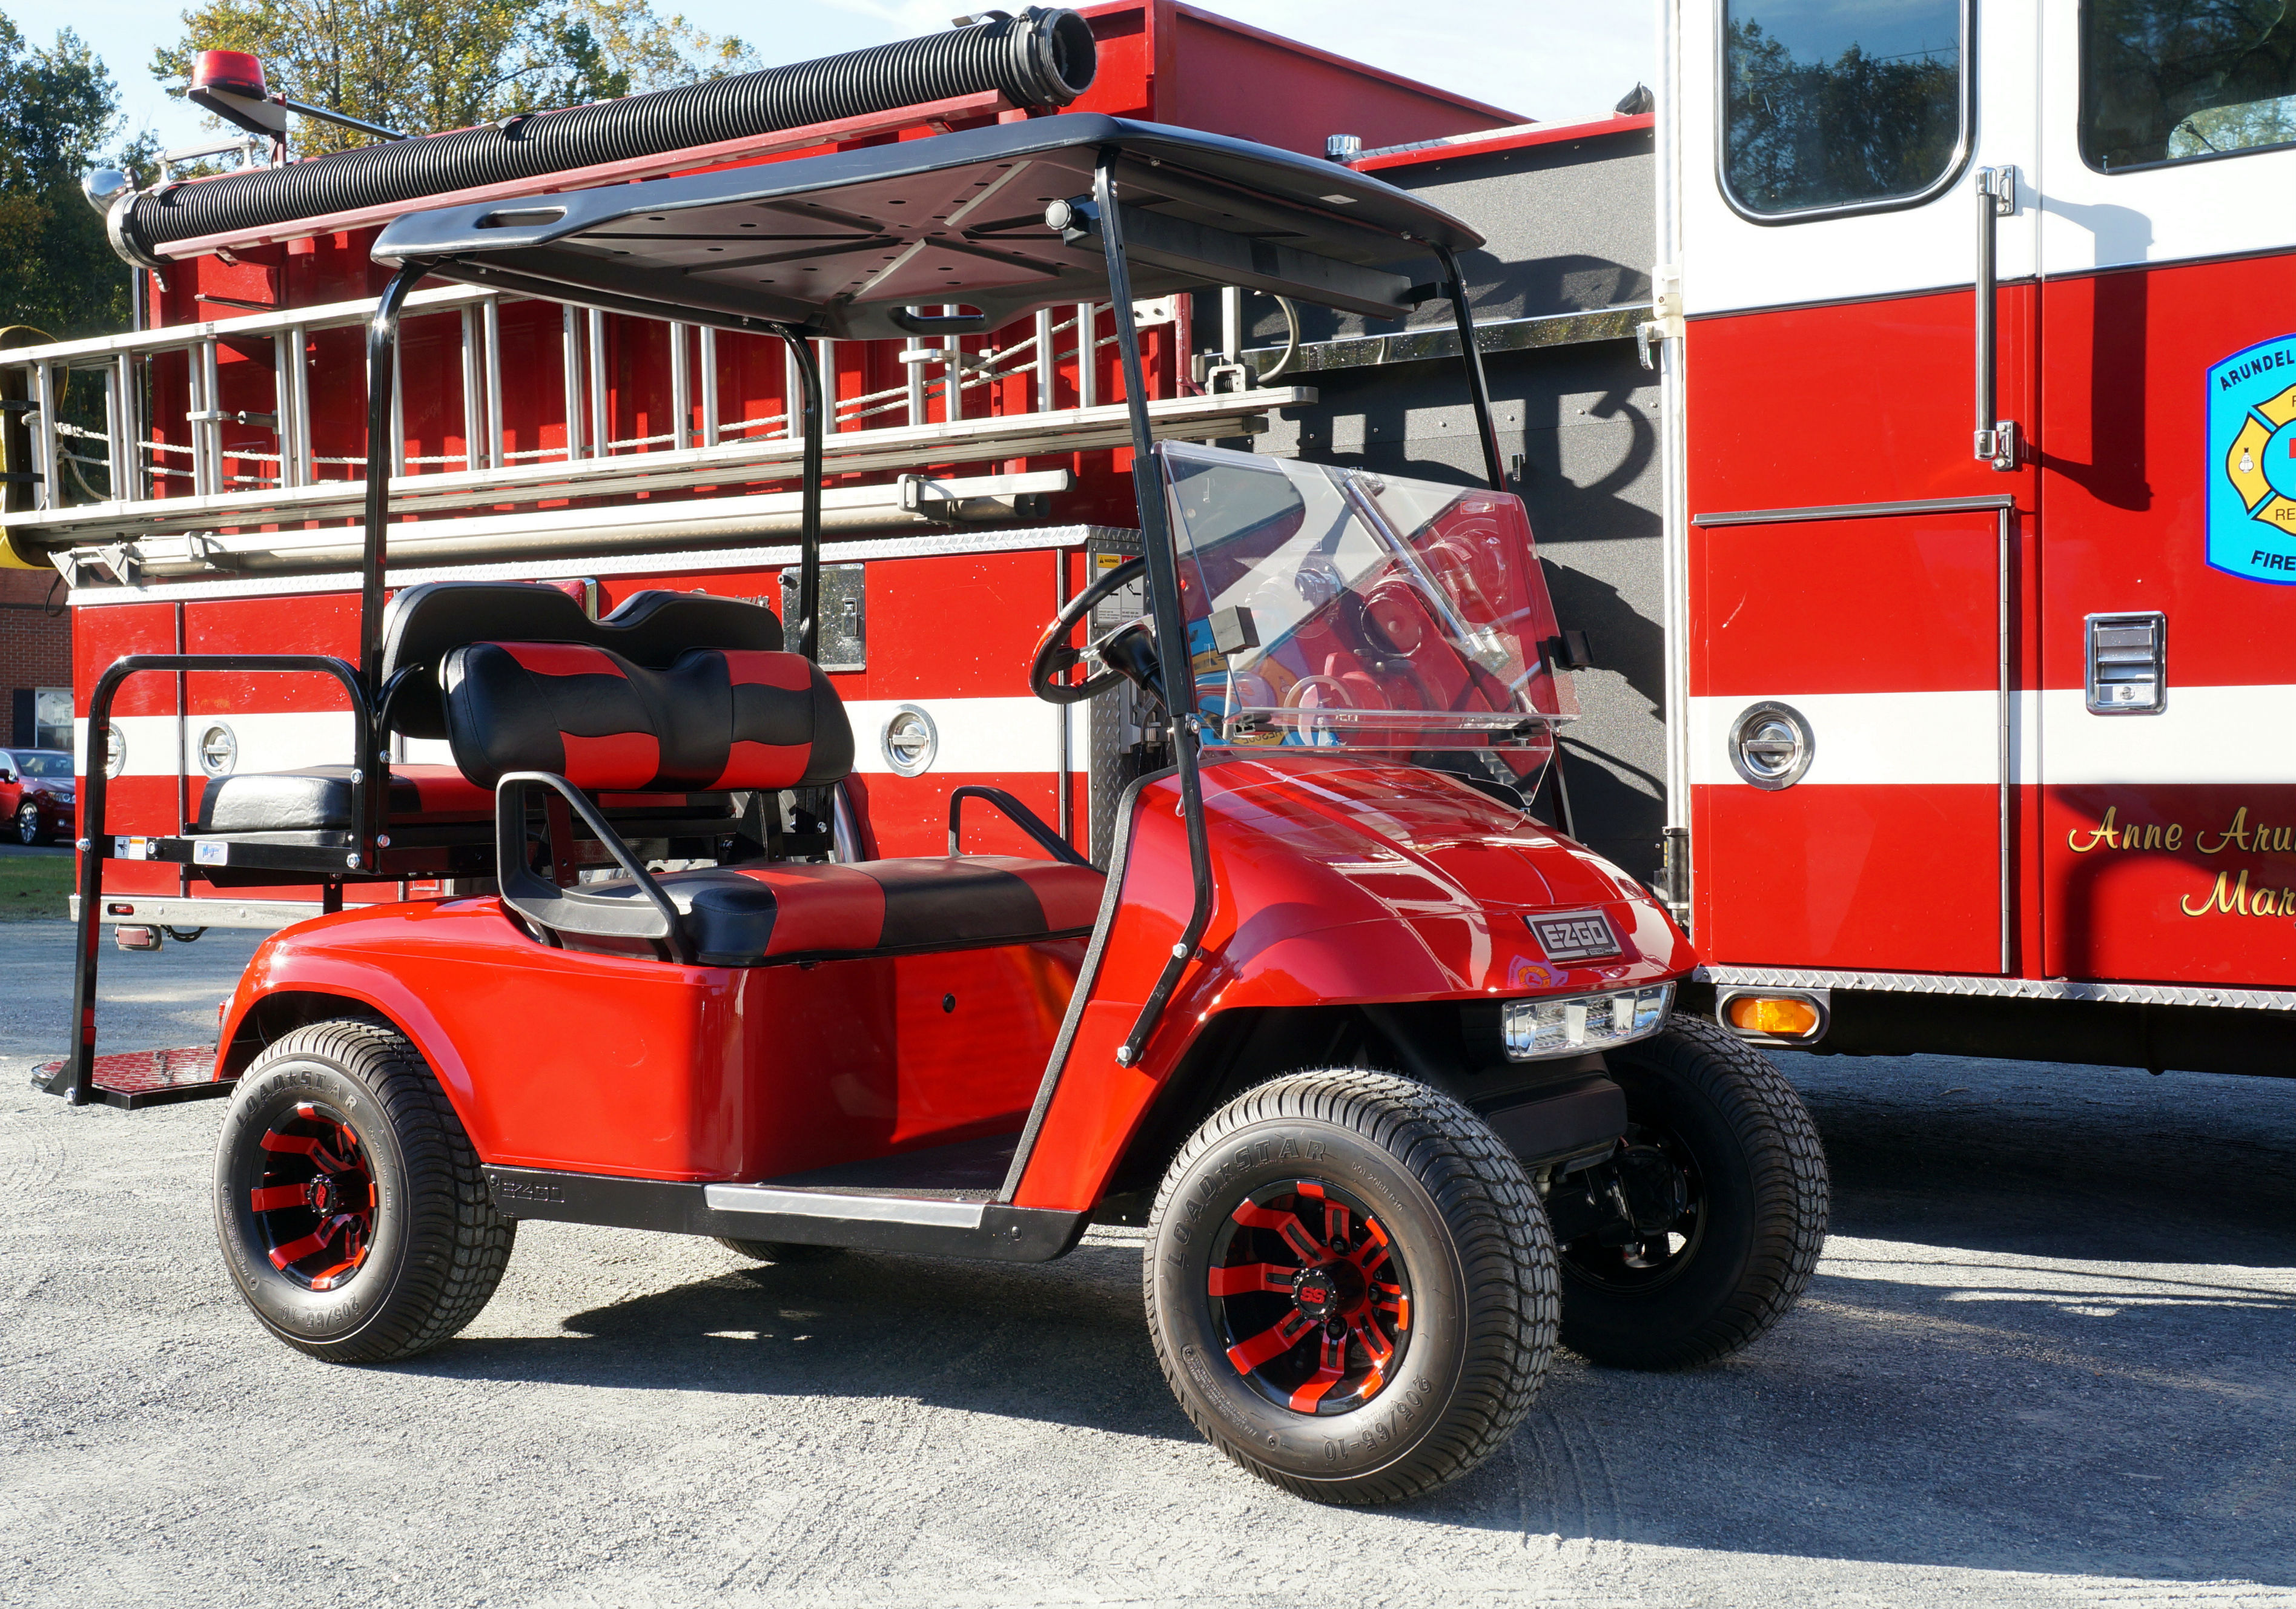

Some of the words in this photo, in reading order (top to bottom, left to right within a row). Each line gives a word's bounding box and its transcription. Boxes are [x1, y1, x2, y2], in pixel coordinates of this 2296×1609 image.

[2219, 349, 2295, 391] ARUNDEL
[2251, 550, 2296, 571] FIRE
[2067, 805, 2183, 853] Anne
[2197, 806, 2296, 854] Aru
[2181, 869, 2296, 918] Mar
[1300, 1286, 1326, 1304] SS
[1324, 1373, 1432, 1462] 205/65-10
